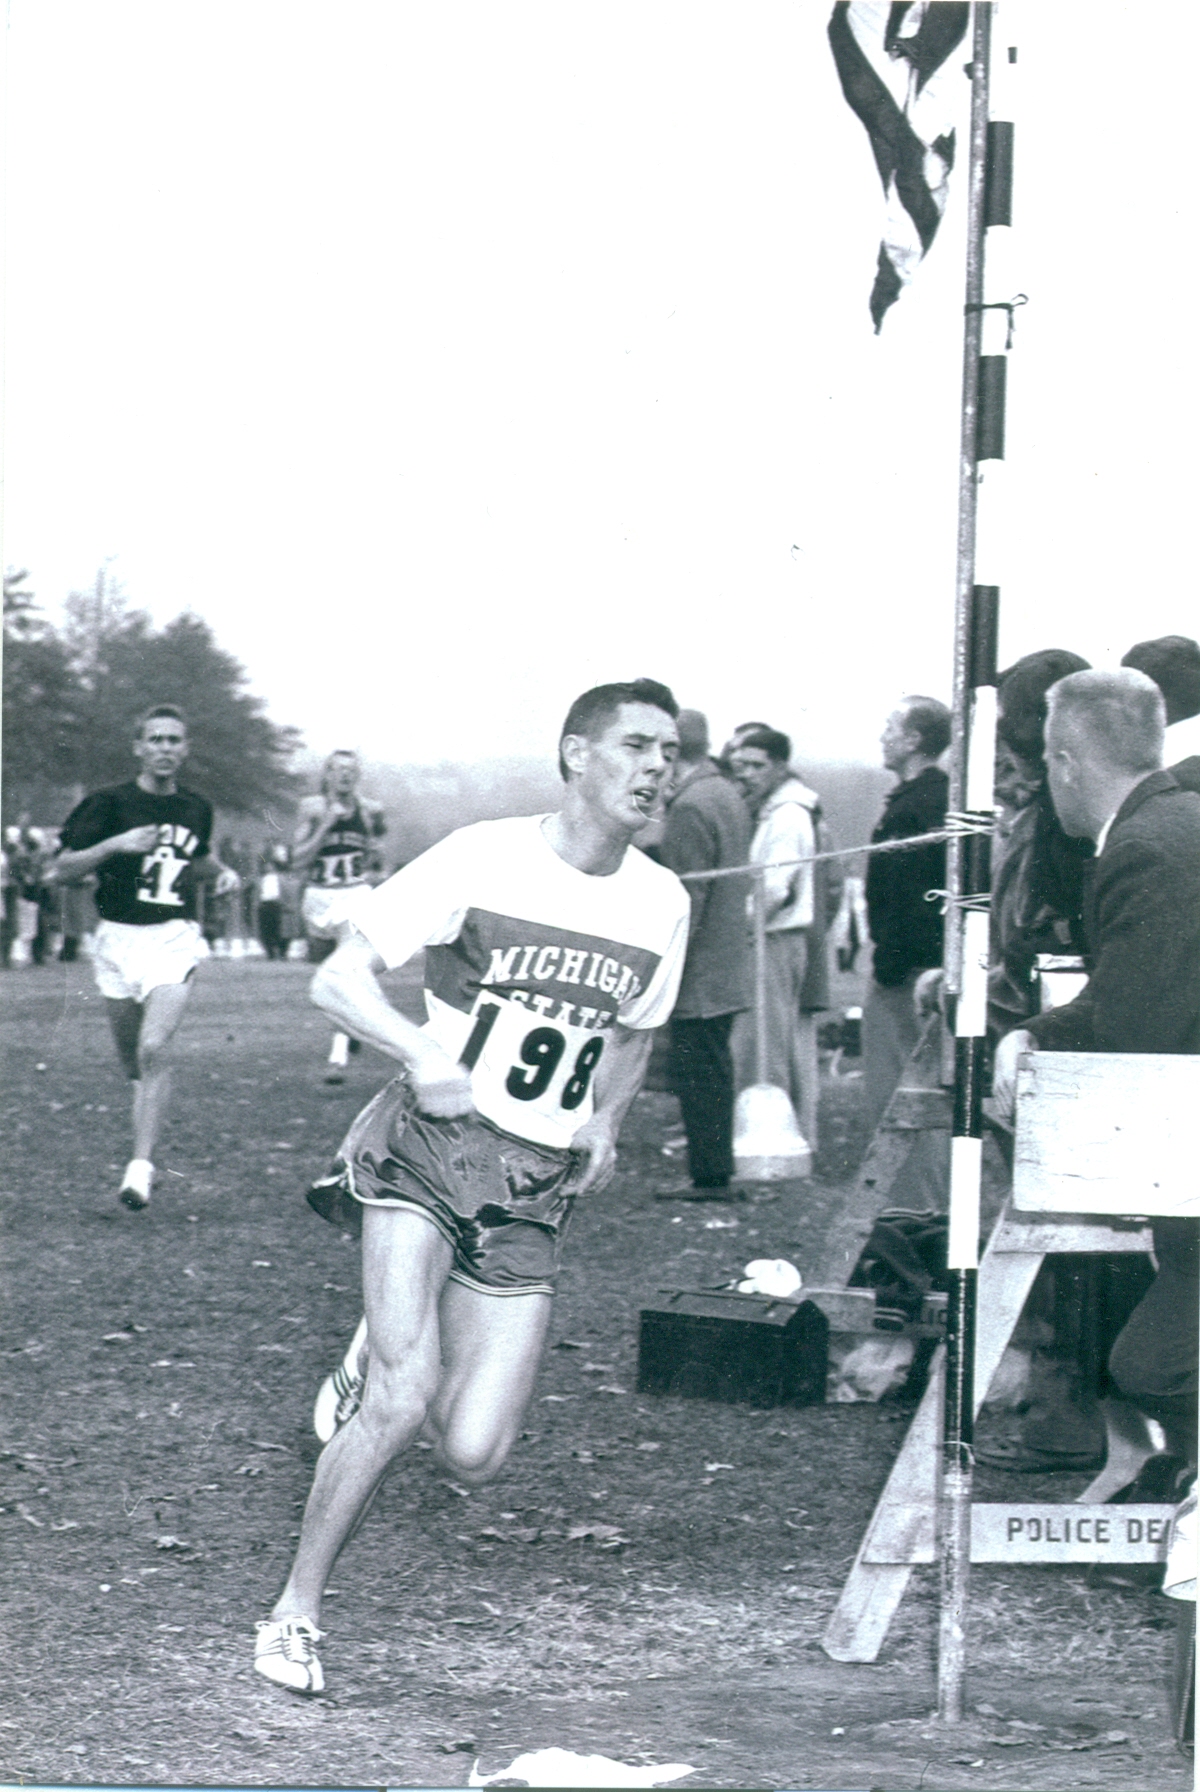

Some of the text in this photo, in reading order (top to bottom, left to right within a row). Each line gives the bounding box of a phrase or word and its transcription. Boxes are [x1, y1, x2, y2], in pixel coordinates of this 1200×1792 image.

[457, 1001, 605, 1111] 198
[1007, 1516, 1172, 1544] POLICE DE
